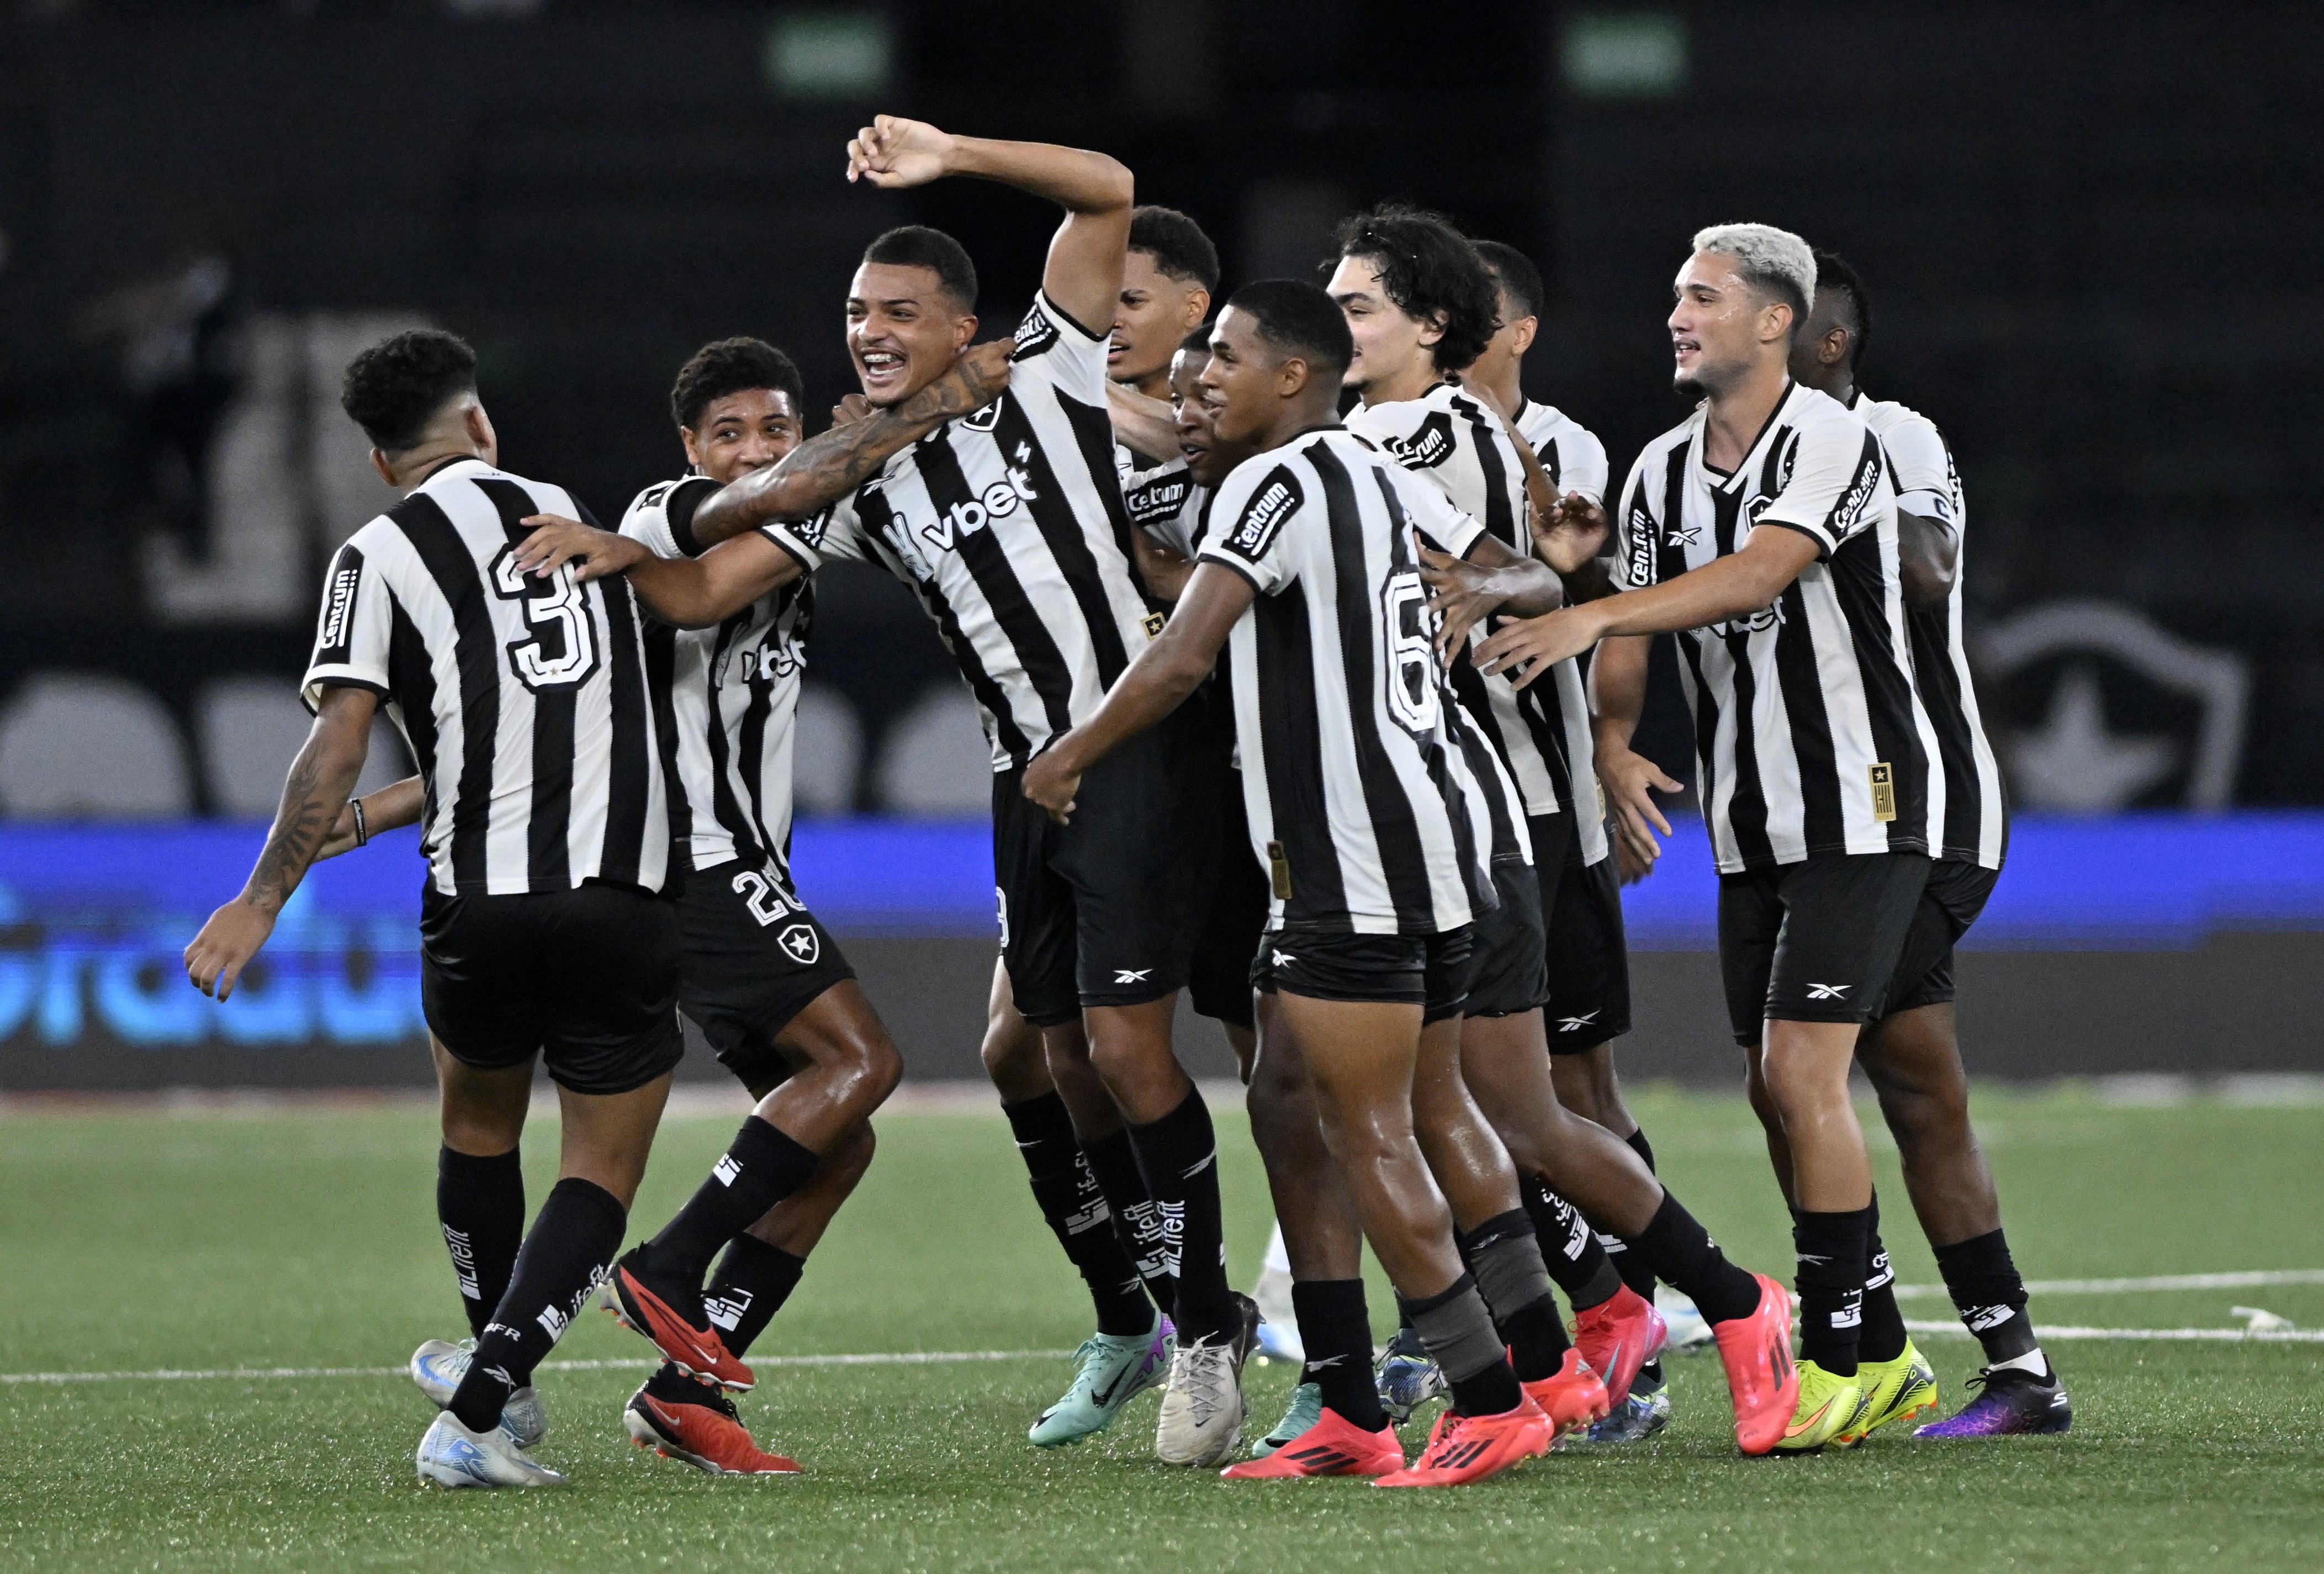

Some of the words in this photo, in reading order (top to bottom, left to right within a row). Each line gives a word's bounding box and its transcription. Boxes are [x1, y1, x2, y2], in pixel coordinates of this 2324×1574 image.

[922, 466, 1039, 551] vbet
[1934, 497, 1951, 520] C
[321, 569, 351, 649] Centrum
[490, 546, 599, 693] 3
[1381, 570, 1440, 733] 6
